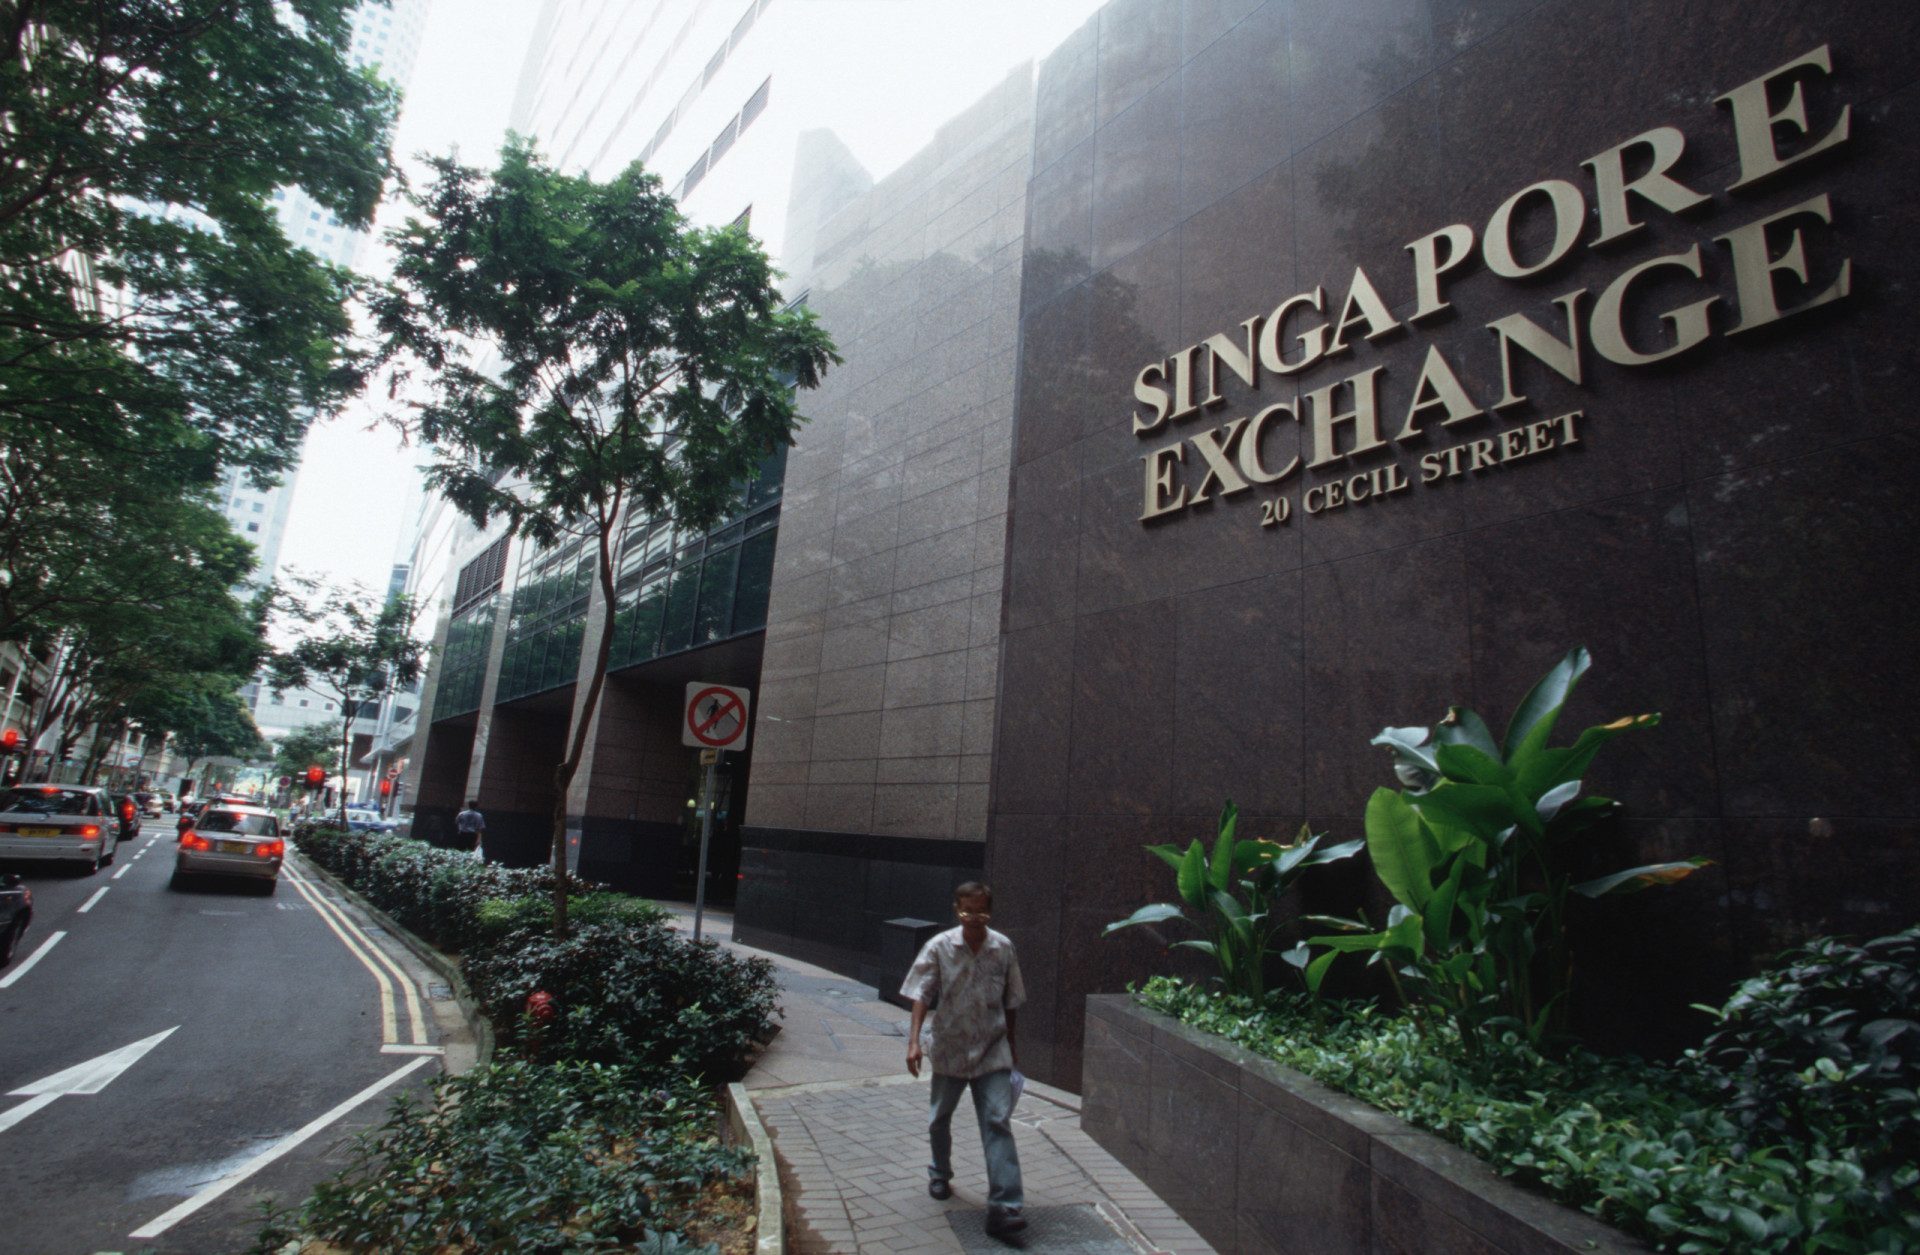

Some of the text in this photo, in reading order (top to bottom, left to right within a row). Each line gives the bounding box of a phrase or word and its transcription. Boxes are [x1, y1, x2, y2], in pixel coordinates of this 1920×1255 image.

[1132, 44, 1852, 435] SINGAPORE
[1138, 193, 1852, 521] EXCHANGE
[1260, 410, 1585, 526] 20 CECIL STREET
